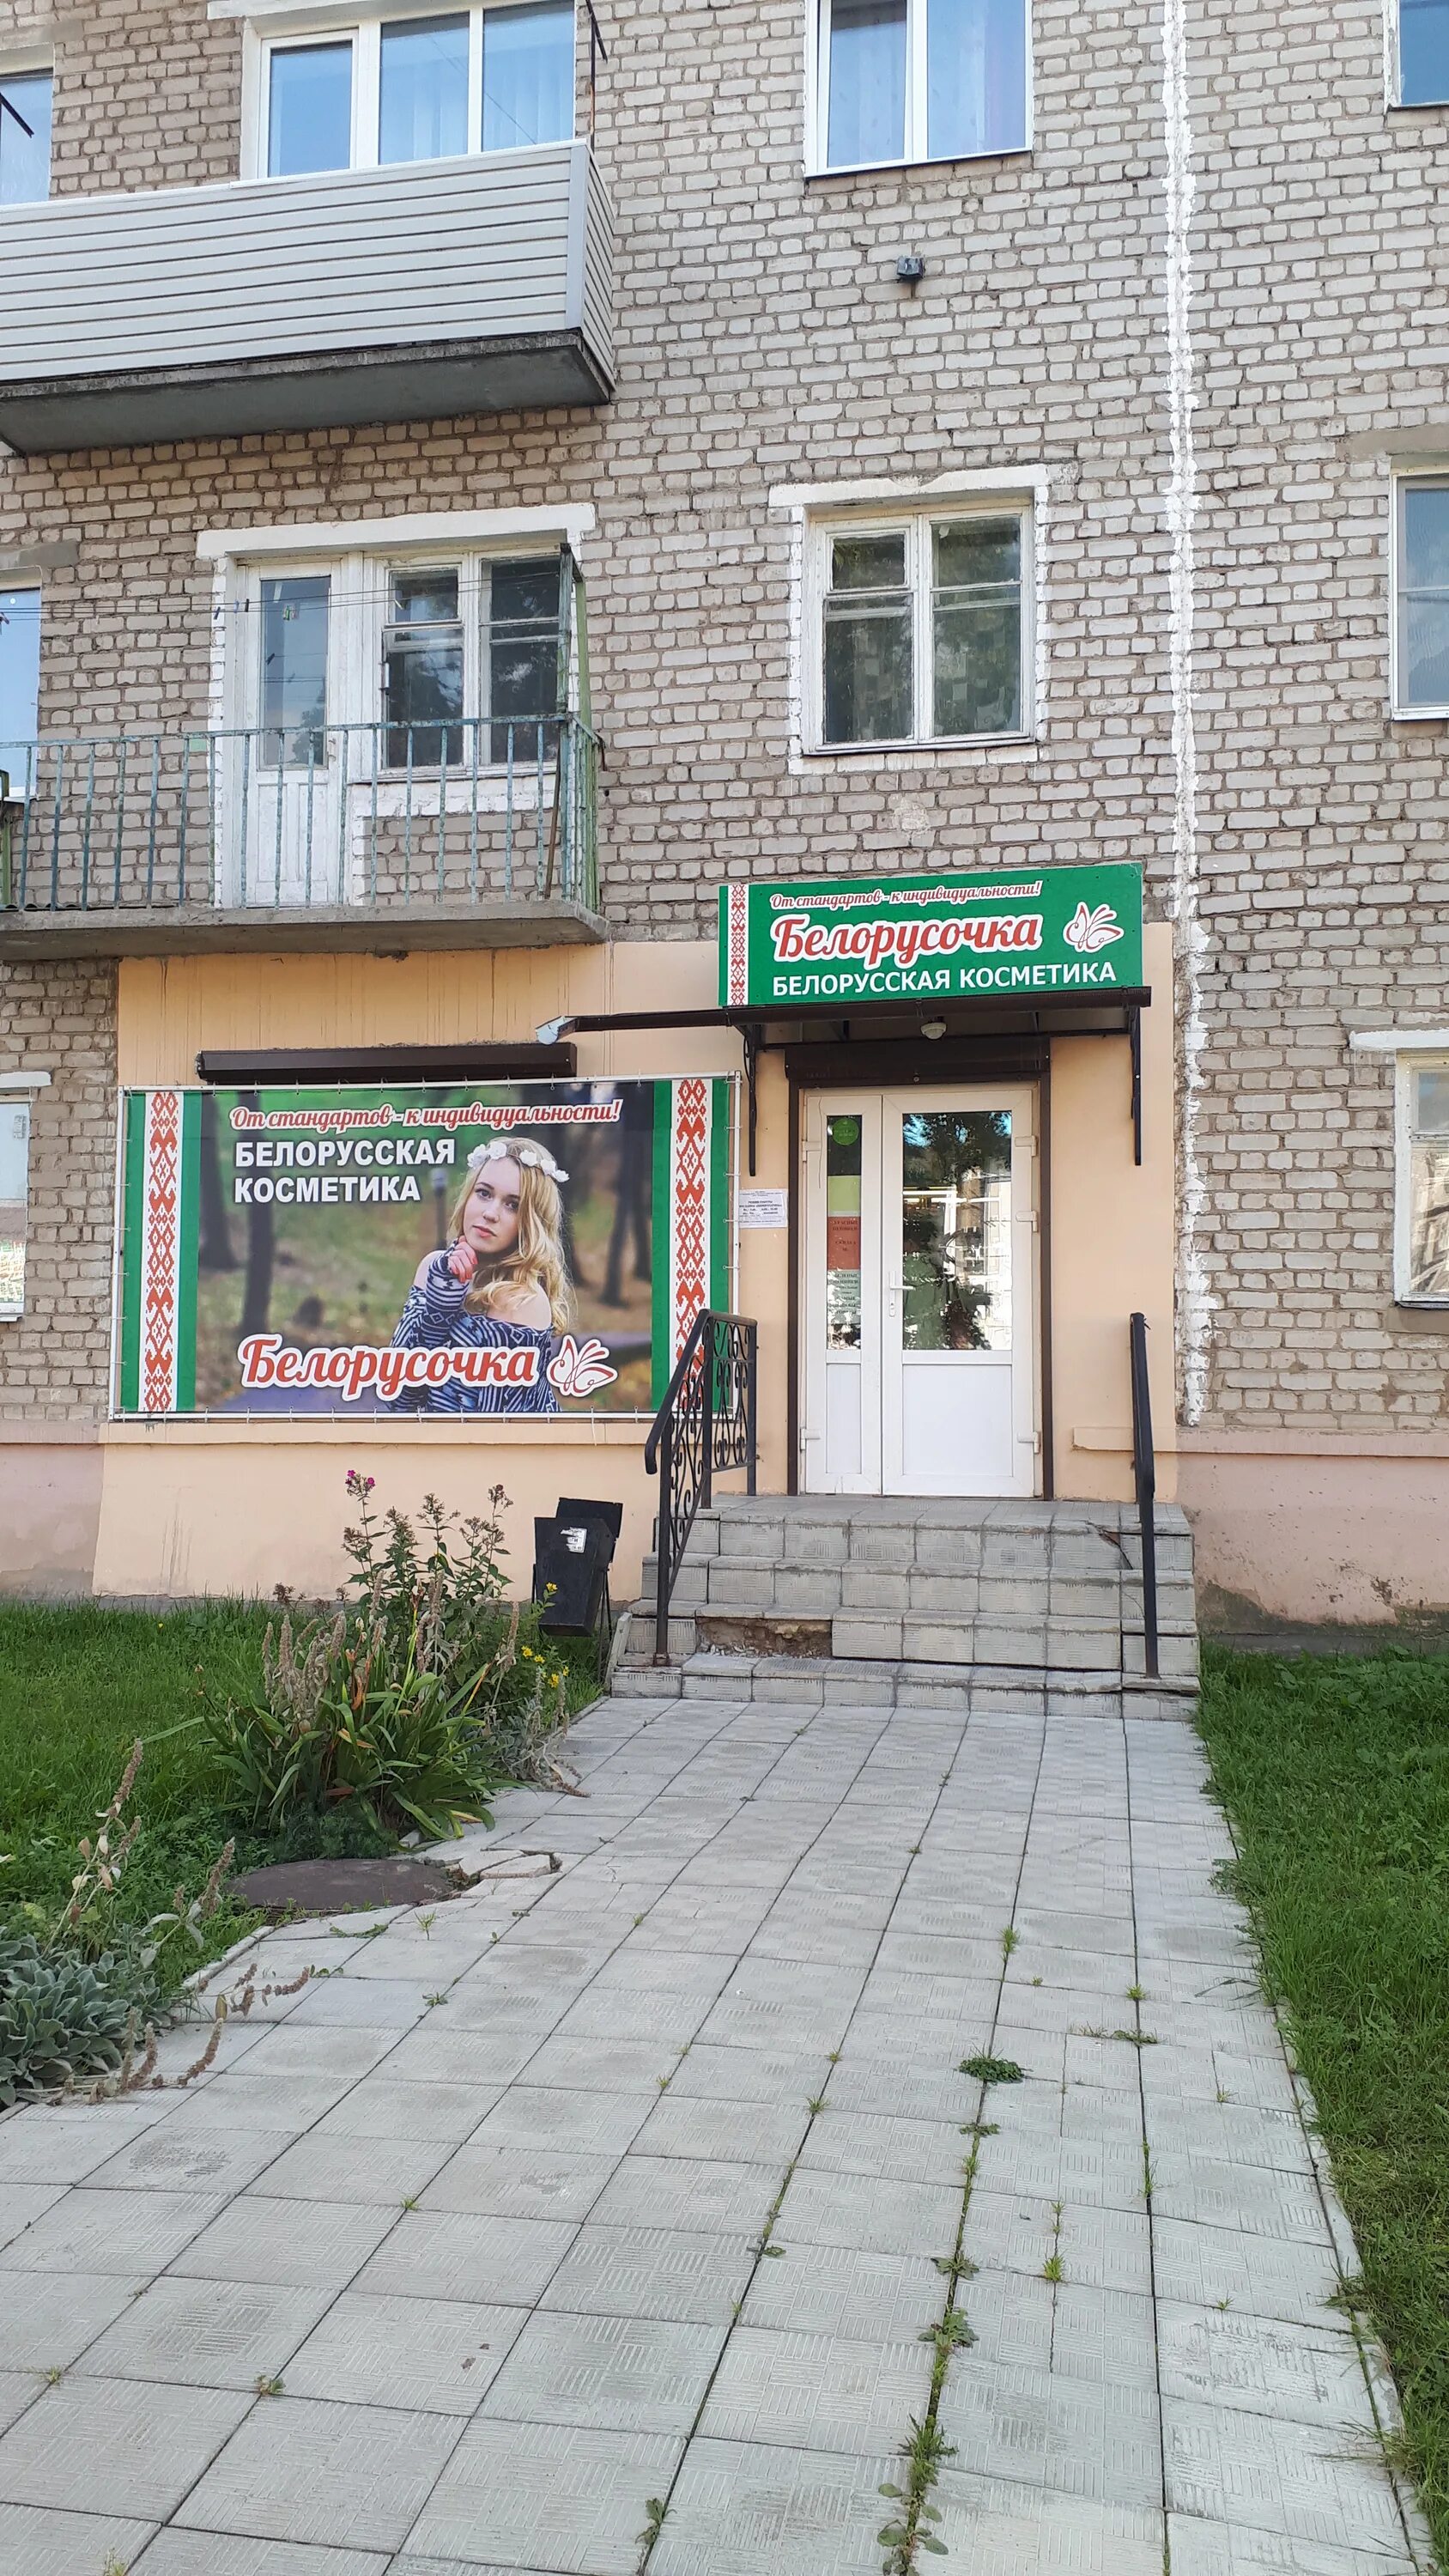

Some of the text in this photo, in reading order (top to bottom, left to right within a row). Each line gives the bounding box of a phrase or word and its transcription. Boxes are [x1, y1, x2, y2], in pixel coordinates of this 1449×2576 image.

[773, 895, 794, 908] От
[797, 890, 882, 909] стандартов
[891, 892, 901, 902] к
[904, 882, 1041, 904] индивидуальности!
[774, 919, 1040, 966] Белорусочка
[773, 961, 1117, 996] БЕЛОРУССКАЯ КОСМЕТИКА
[232, 1107, 265, 1127] От
[268, 1104, 394, 1132] стандартов
[405, 1111, 420, 1125] к
[423, 1102, 621, 1128] индивидуальности!
[235, 1139, 456, 1168] БЕЛОРУССКАЯ
[234, 1176, 421, 1203] КОСМЕТИКА
[242, 1339, 535, 1395] Белорусочка
